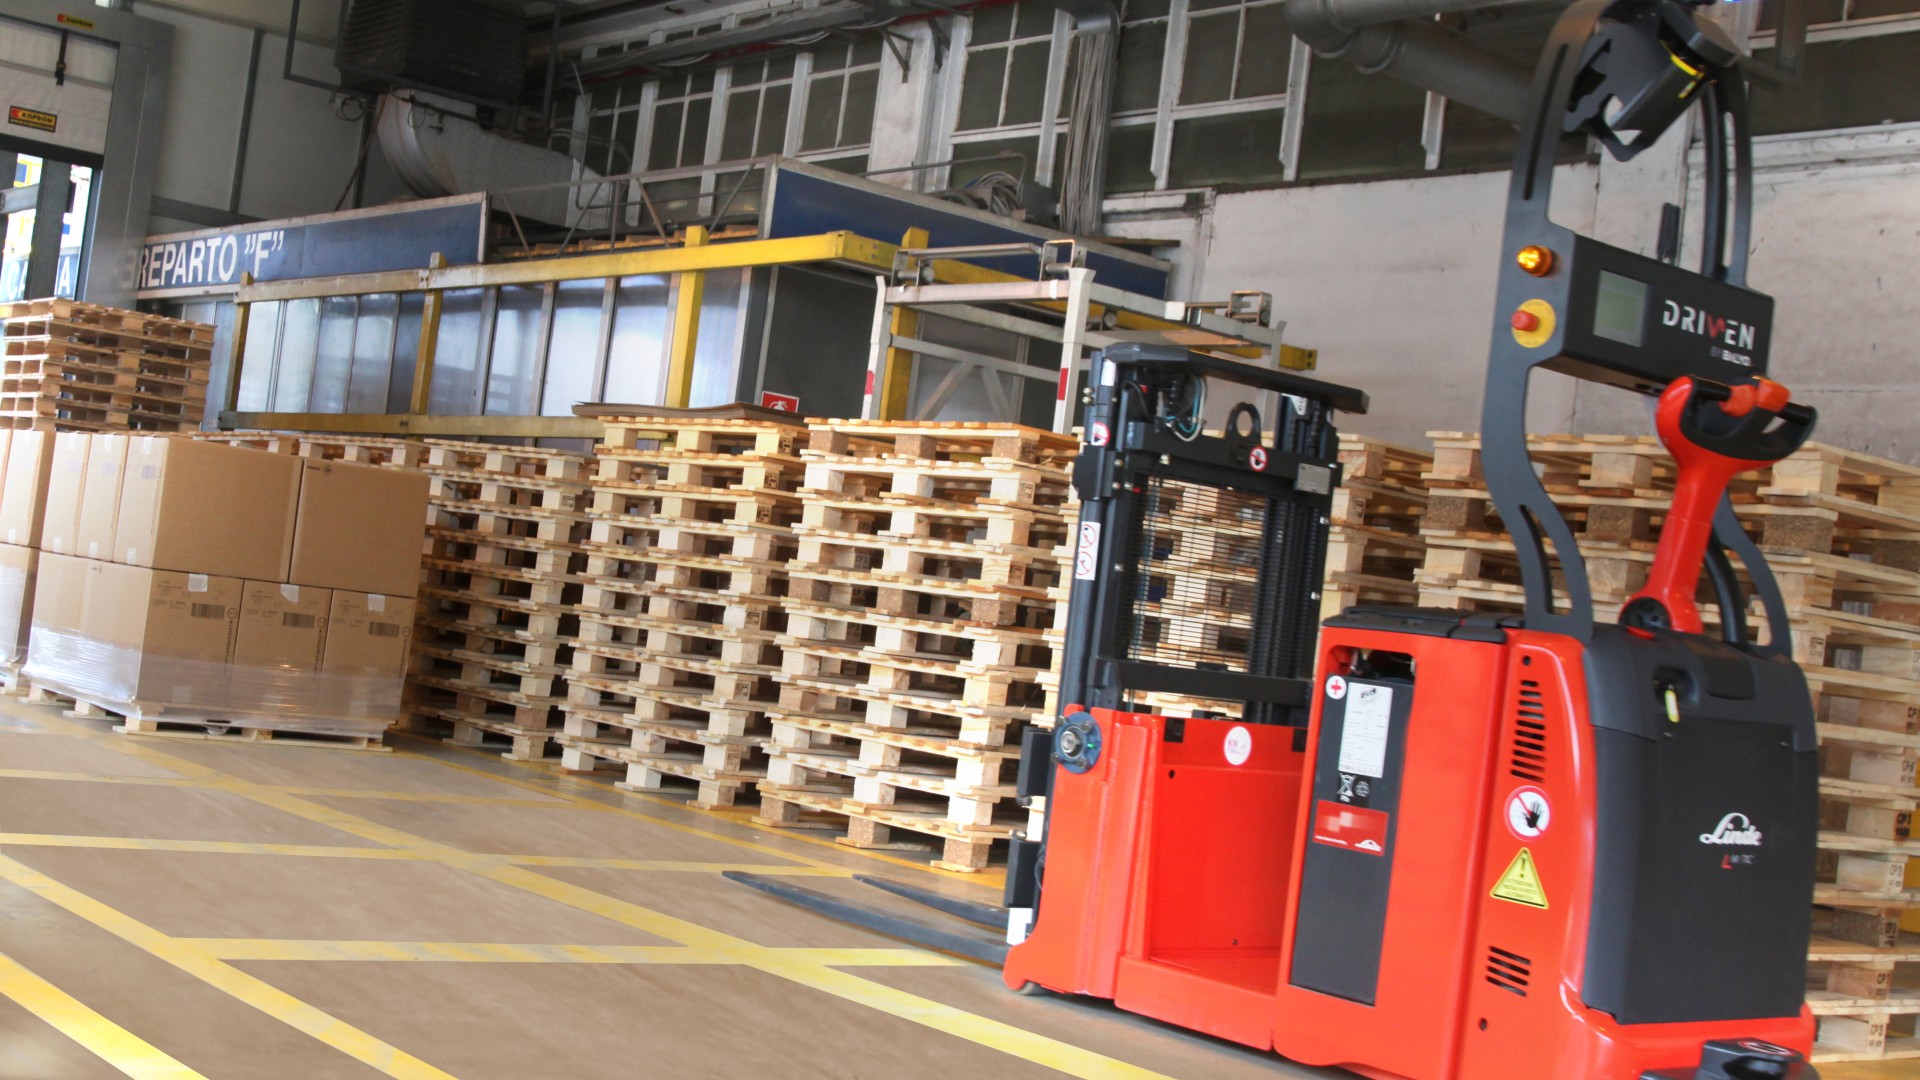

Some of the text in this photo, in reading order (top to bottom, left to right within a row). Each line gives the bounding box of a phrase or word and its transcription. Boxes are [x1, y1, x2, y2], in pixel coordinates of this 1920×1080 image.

[21, 112, 53, 124] KOPRON
[1662, 299, 1755, 350] DRIVEN
[1699, 812, 1762, 846] Linde
